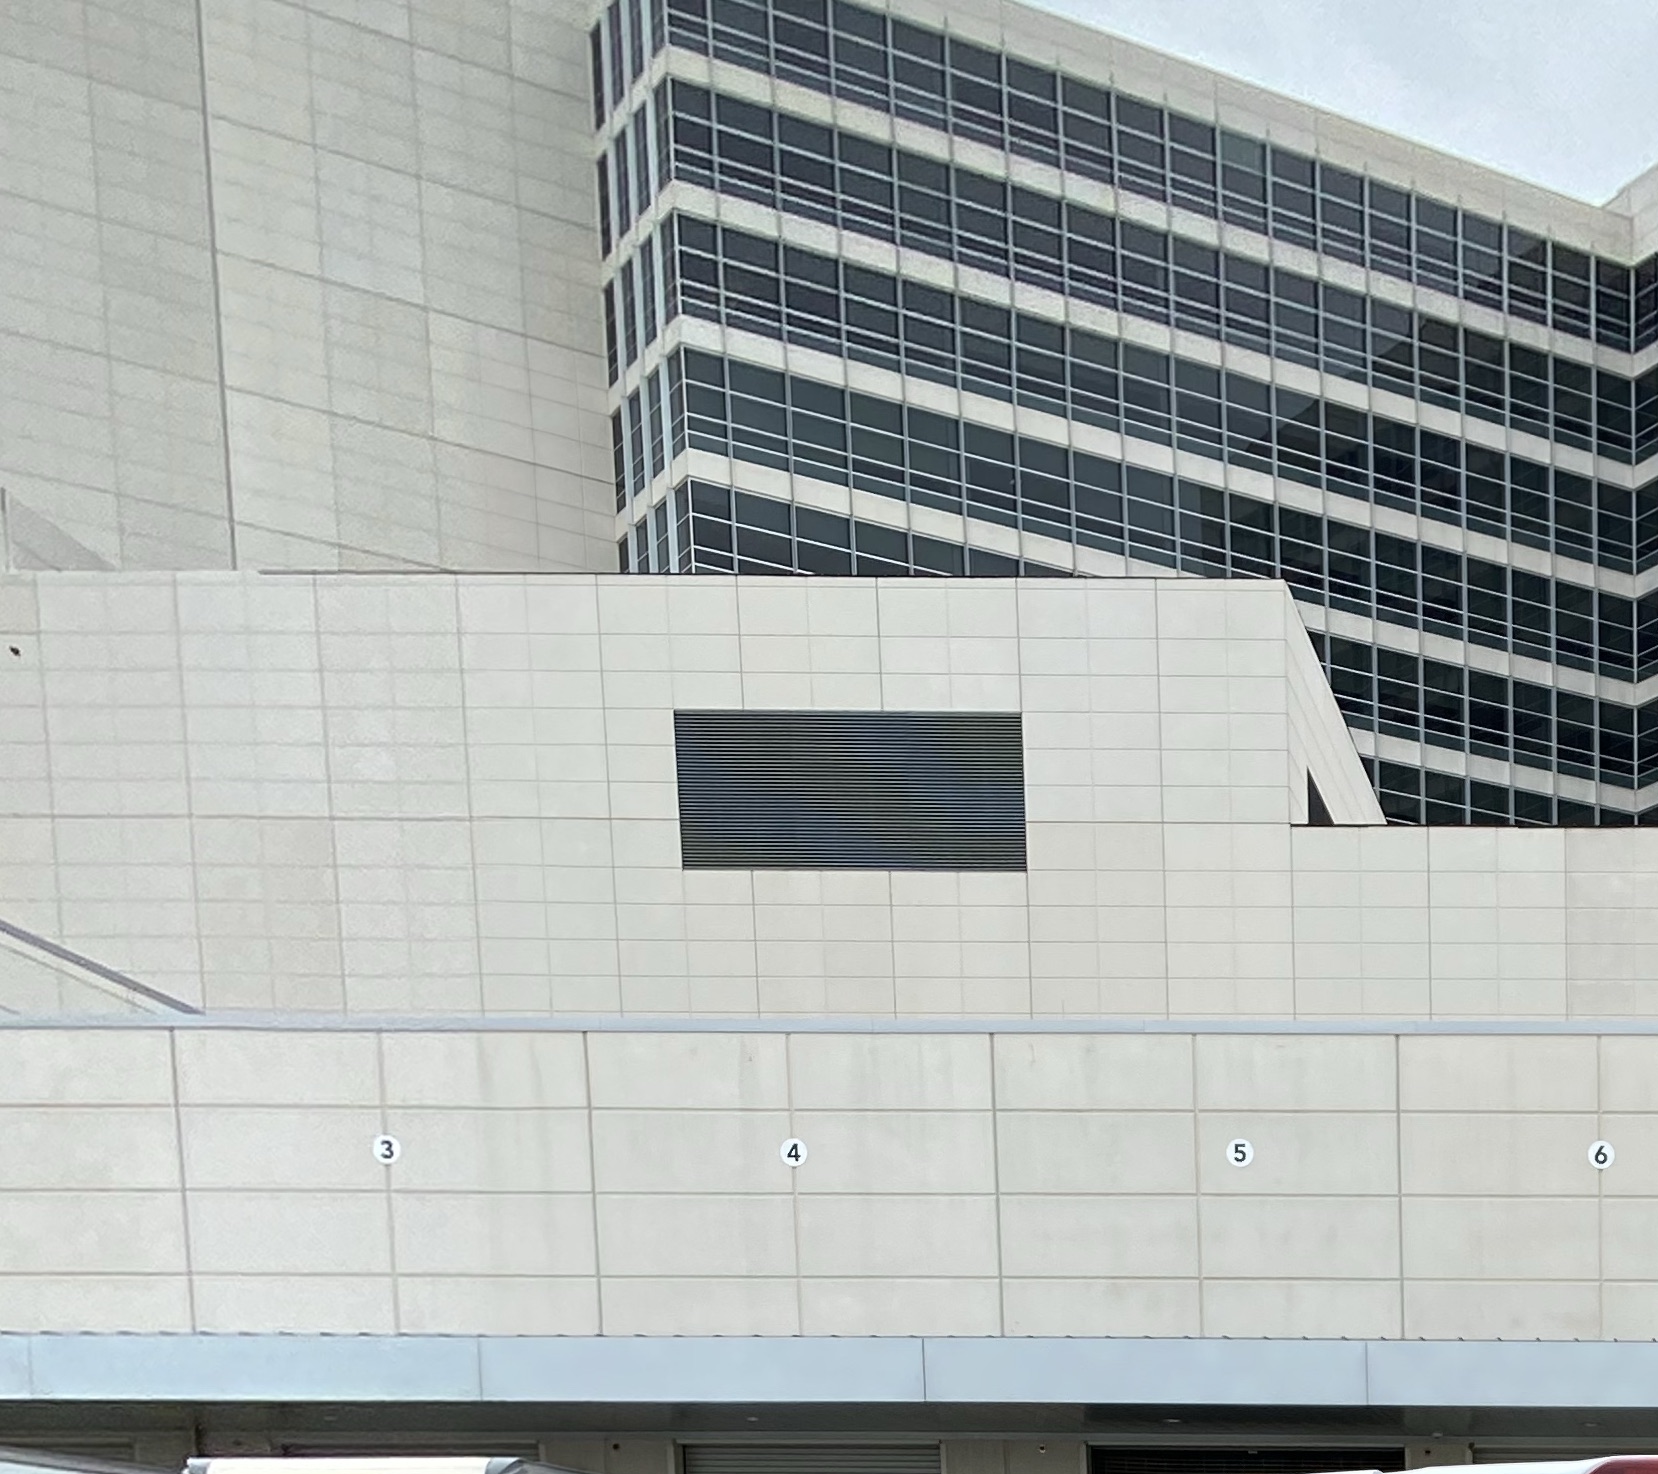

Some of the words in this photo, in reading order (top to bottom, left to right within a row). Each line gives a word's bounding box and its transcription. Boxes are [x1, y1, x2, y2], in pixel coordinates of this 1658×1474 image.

[381, 1140, 394, 1159] 3
[787, 1144, 800, 1161] 4
[1235, 1144, 1246, 1162] 5
[1595, 1146, 1607, 1164] 6
